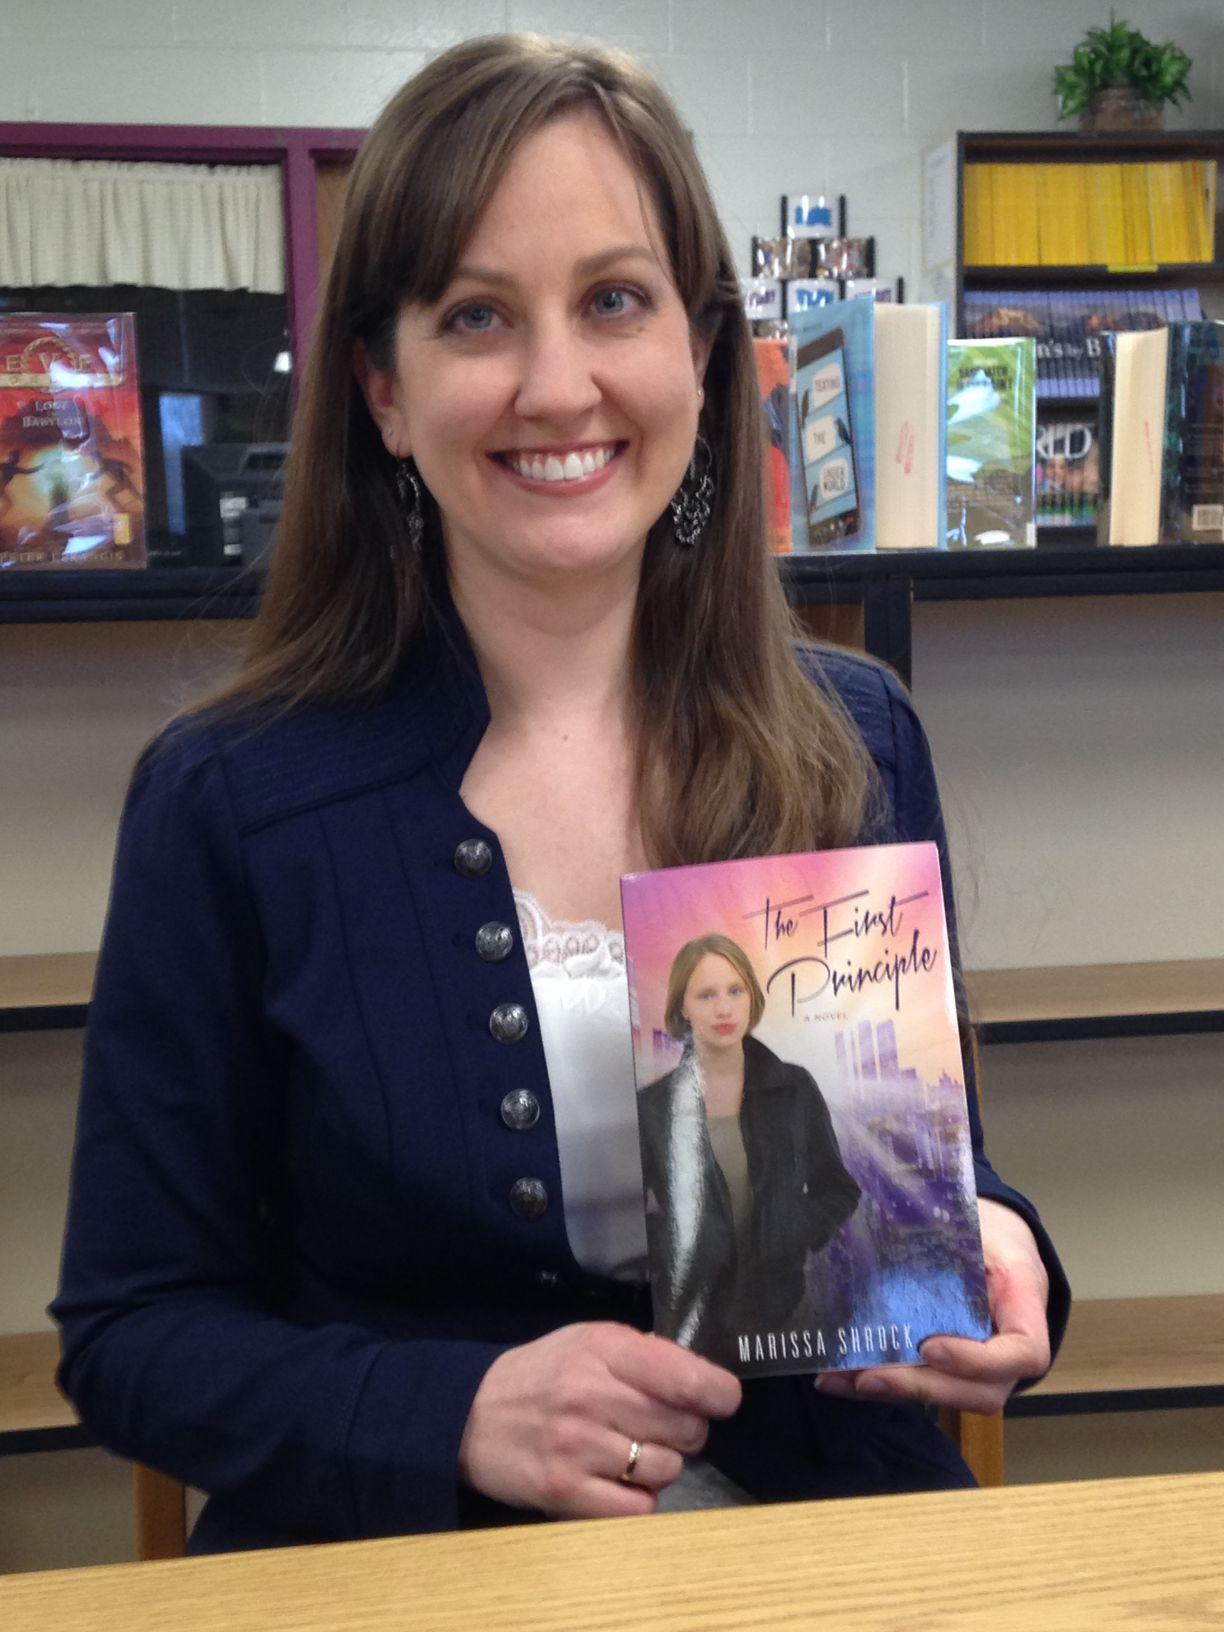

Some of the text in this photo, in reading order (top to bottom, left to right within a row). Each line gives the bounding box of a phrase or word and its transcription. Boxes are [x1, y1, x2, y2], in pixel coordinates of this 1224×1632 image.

[742, 889, 929, 959] The First
[766, 929, 938, 1018] Principle
[804, 1012, 849, 1023] A NOVEL
[738, 1322, 913, 1363] MARISSA SHROCK
